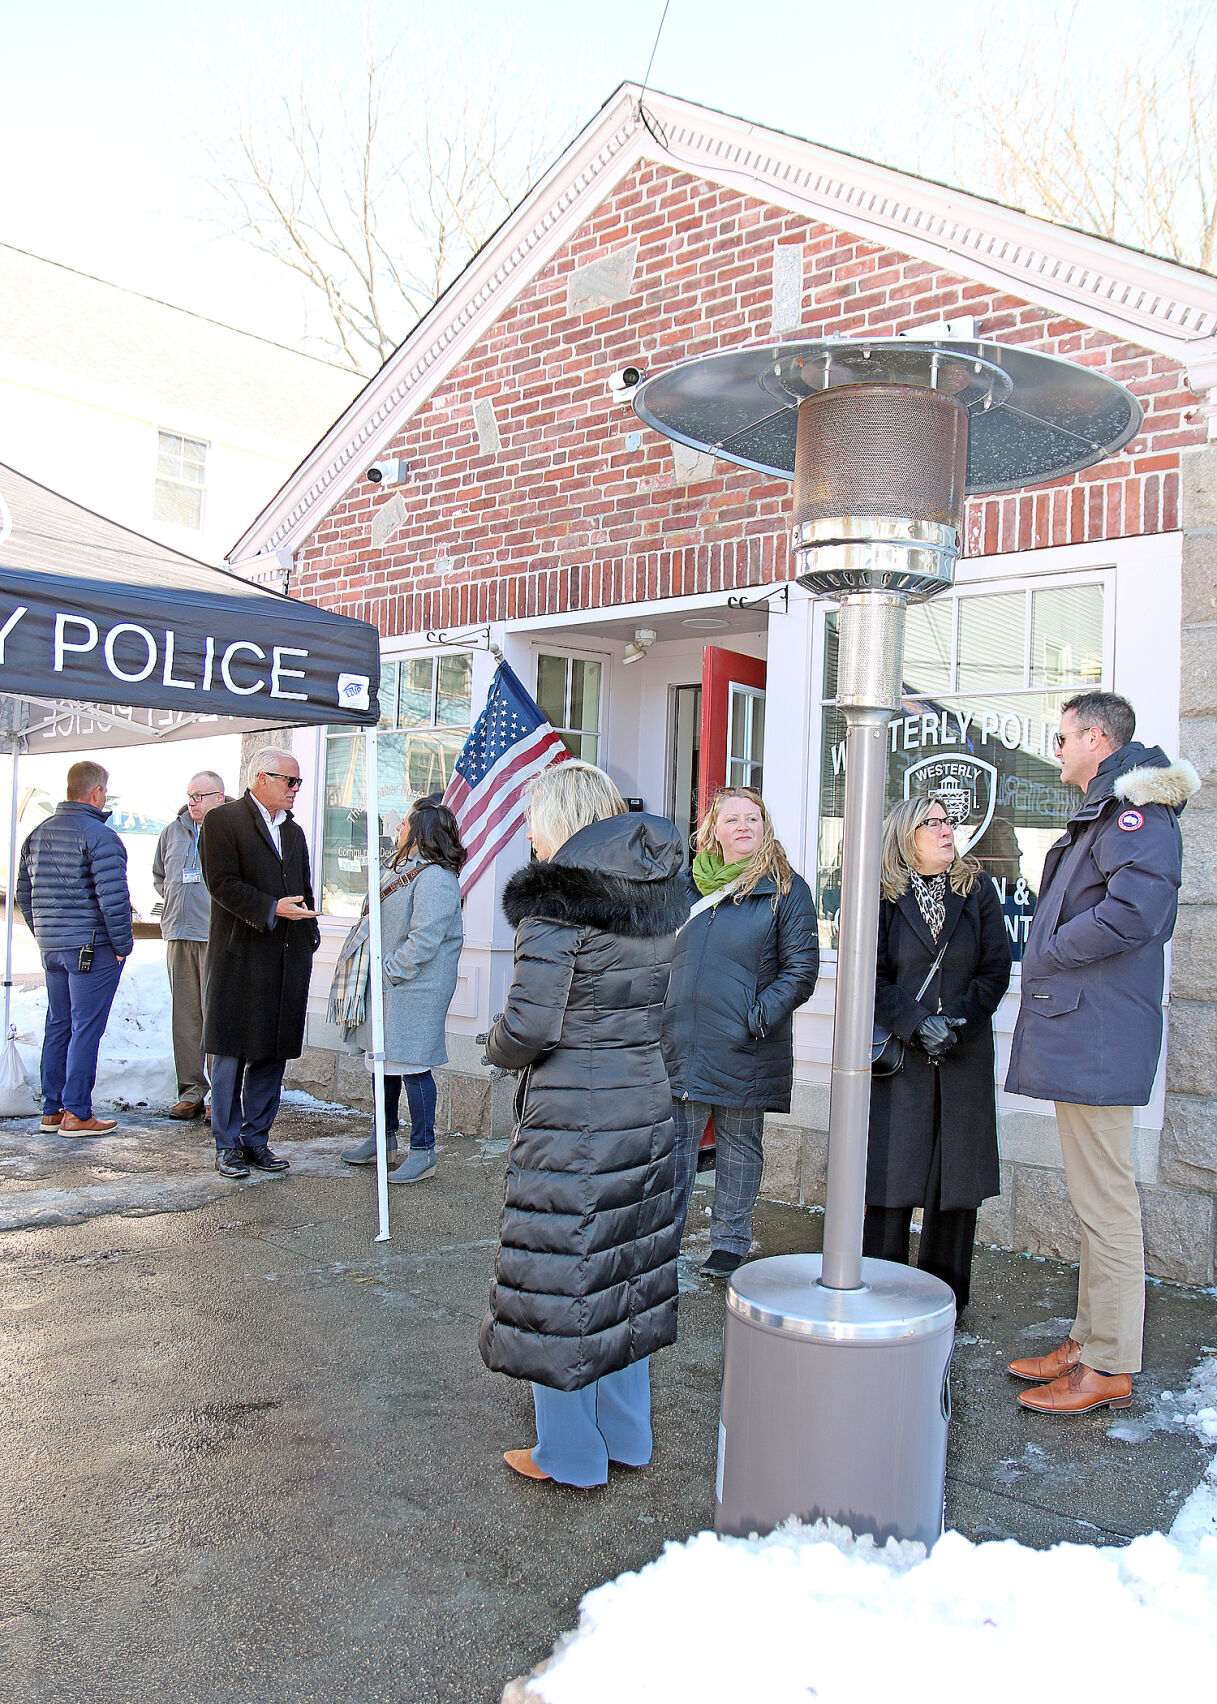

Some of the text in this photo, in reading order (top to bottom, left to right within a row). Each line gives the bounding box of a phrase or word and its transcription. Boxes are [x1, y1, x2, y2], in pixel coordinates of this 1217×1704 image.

[53, 611, 310, 701] POLICE
[831, 711, 974, 776] WTERLY
[915, 763, 983, 783] WESTERLY
[1013, 877, 1030, 905] &
